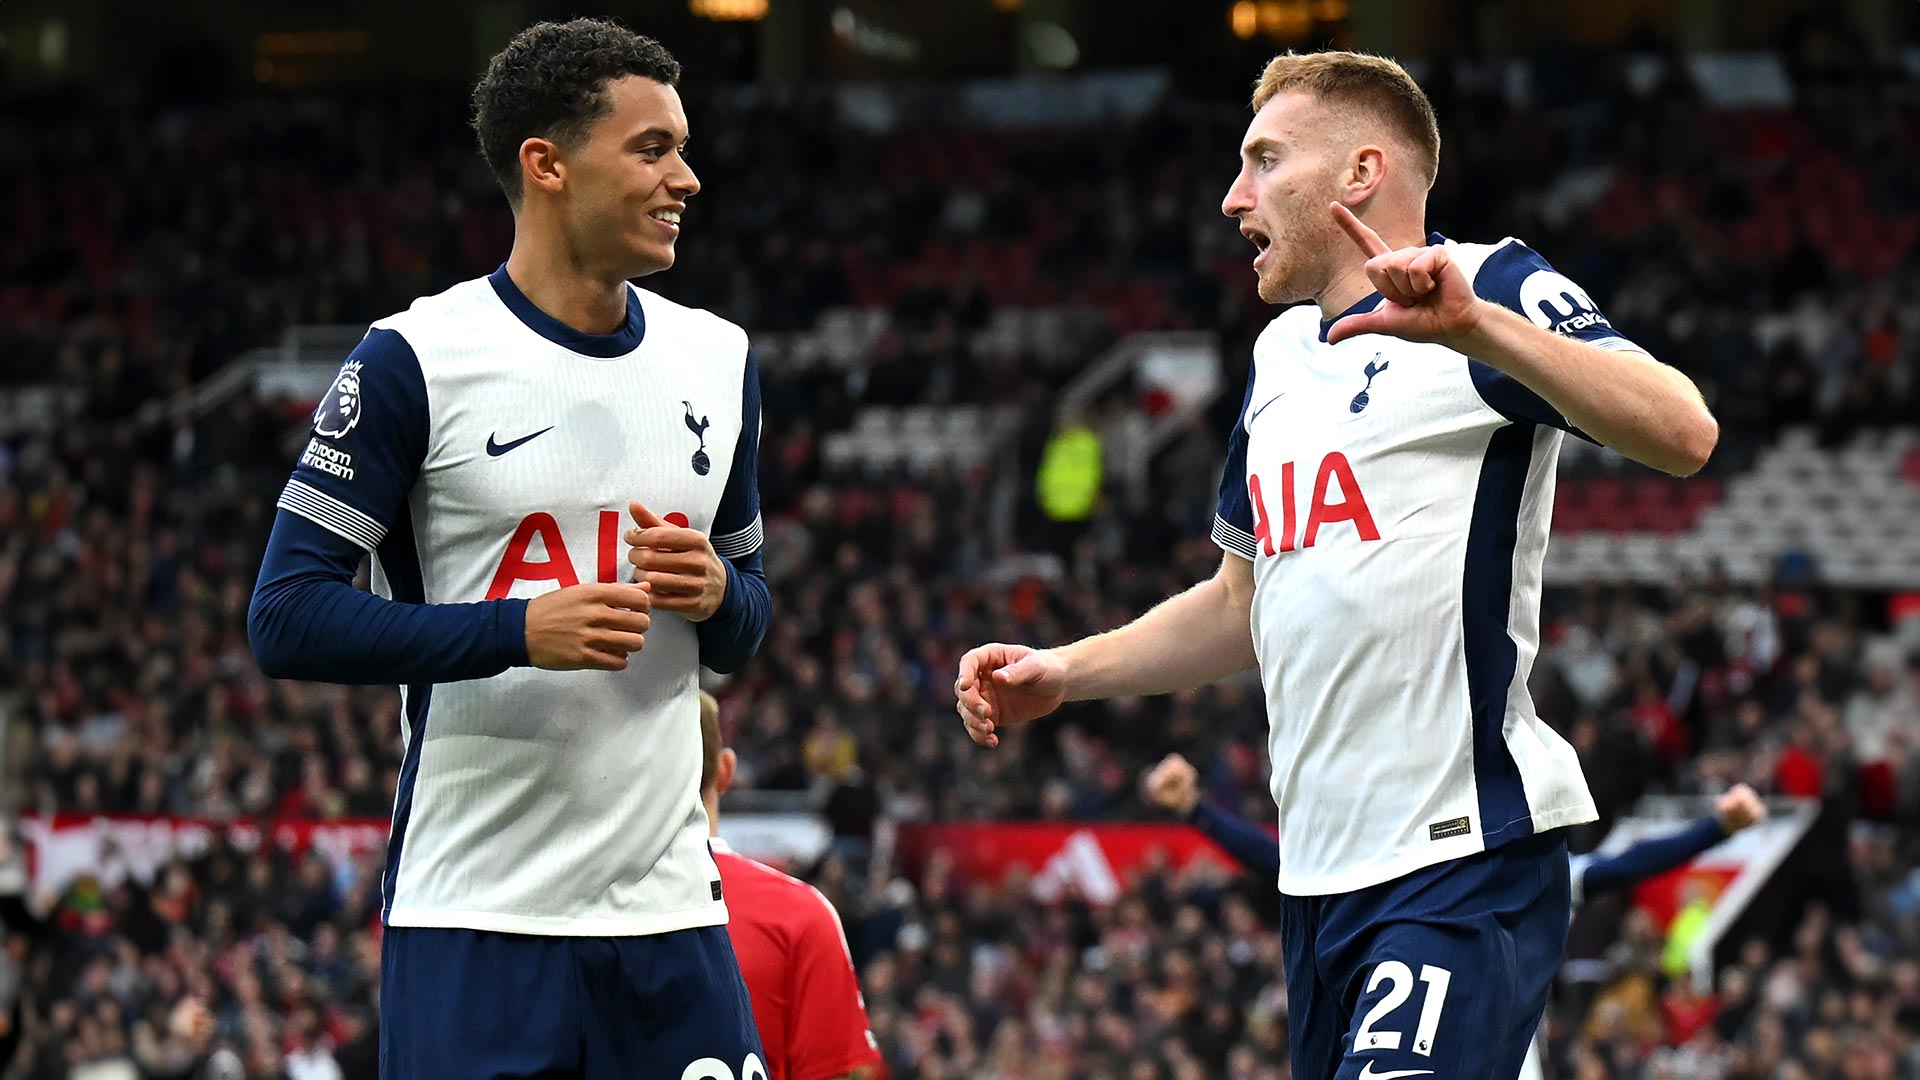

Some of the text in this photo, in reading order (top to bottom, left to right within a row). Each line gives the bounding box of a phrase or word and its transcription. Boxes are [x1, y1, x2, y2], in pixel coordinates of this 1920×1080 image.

[310, 455, 354, 480] racism
[316, 444, 351, 466] room
[1250, 451, 1381, 558] AIA
[485, 511, 690, 600] AI
[1353, 960, 1452, 1057] 21
